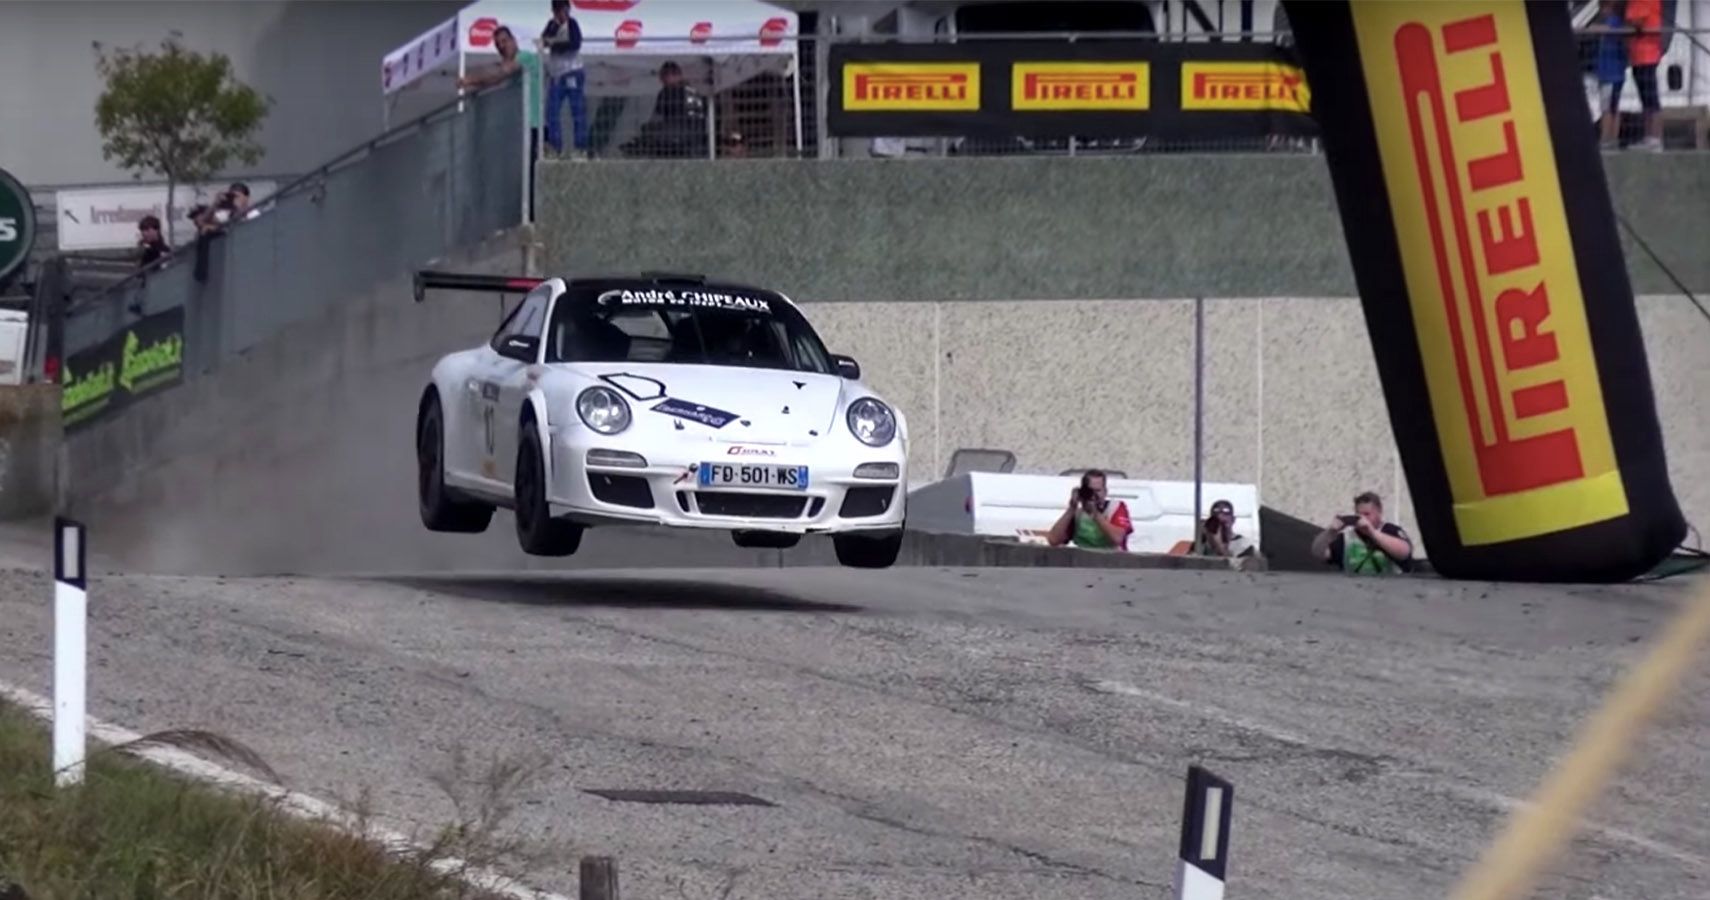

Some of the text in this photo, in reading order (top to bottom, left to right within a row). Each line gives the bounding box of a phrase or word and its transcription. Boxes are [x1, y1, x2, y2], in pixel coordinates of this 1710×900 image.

[854, 73, 968, 101] PIRELLI
[1023, 73, 1138, 101] PIRELLI
[1394, 14, 1585, 497] PIRELLI
